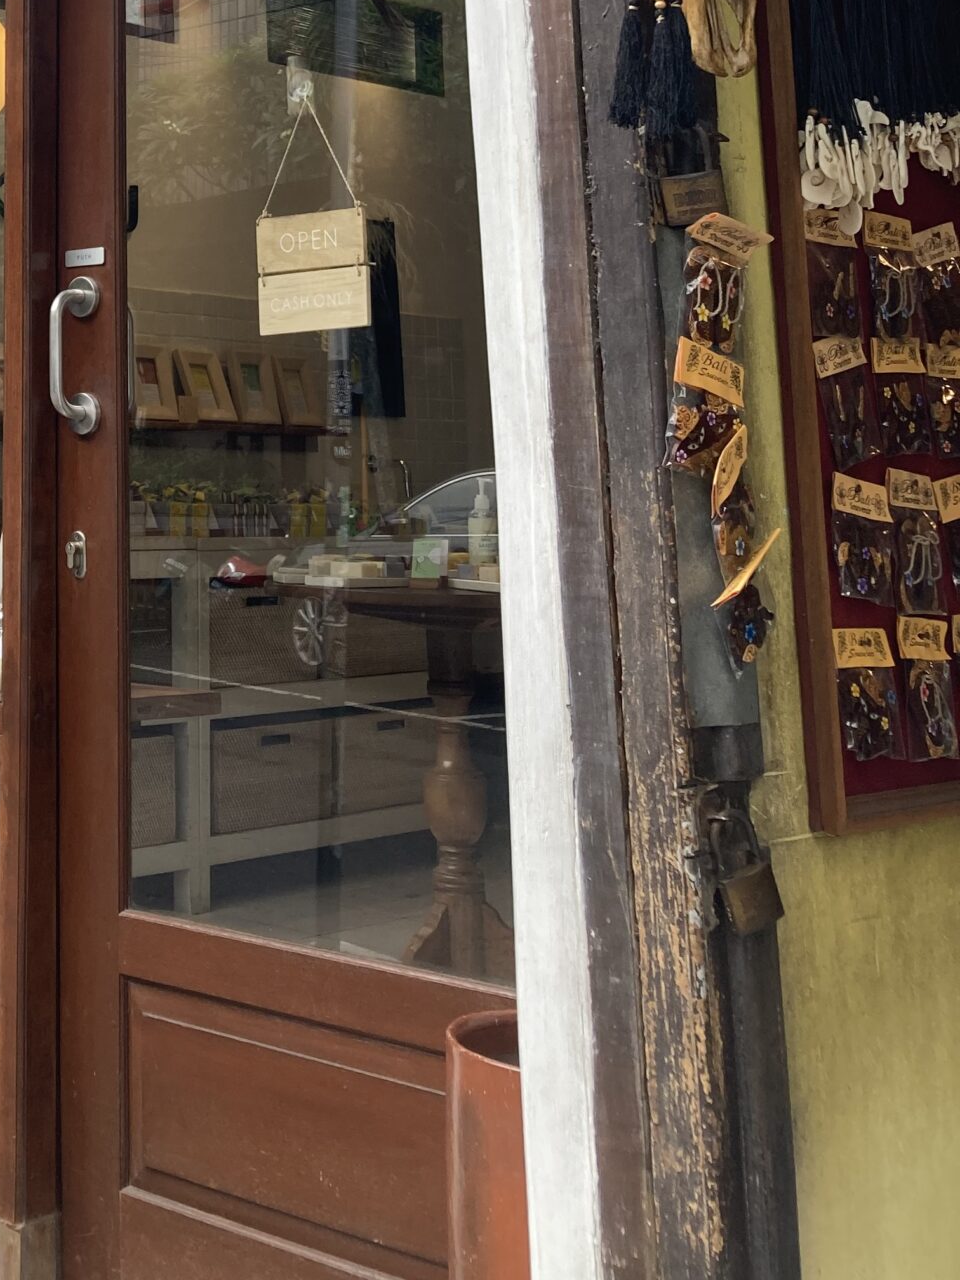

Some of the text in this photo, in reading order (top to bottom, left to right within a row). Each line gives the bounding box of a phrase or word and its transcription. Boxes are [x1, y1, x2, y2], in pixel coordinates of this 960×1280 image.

[279, 228, 338, 253] OPEN
[270, 291, 353, 313] CASH ONLY
[701, 352, 728, 375] Bali
